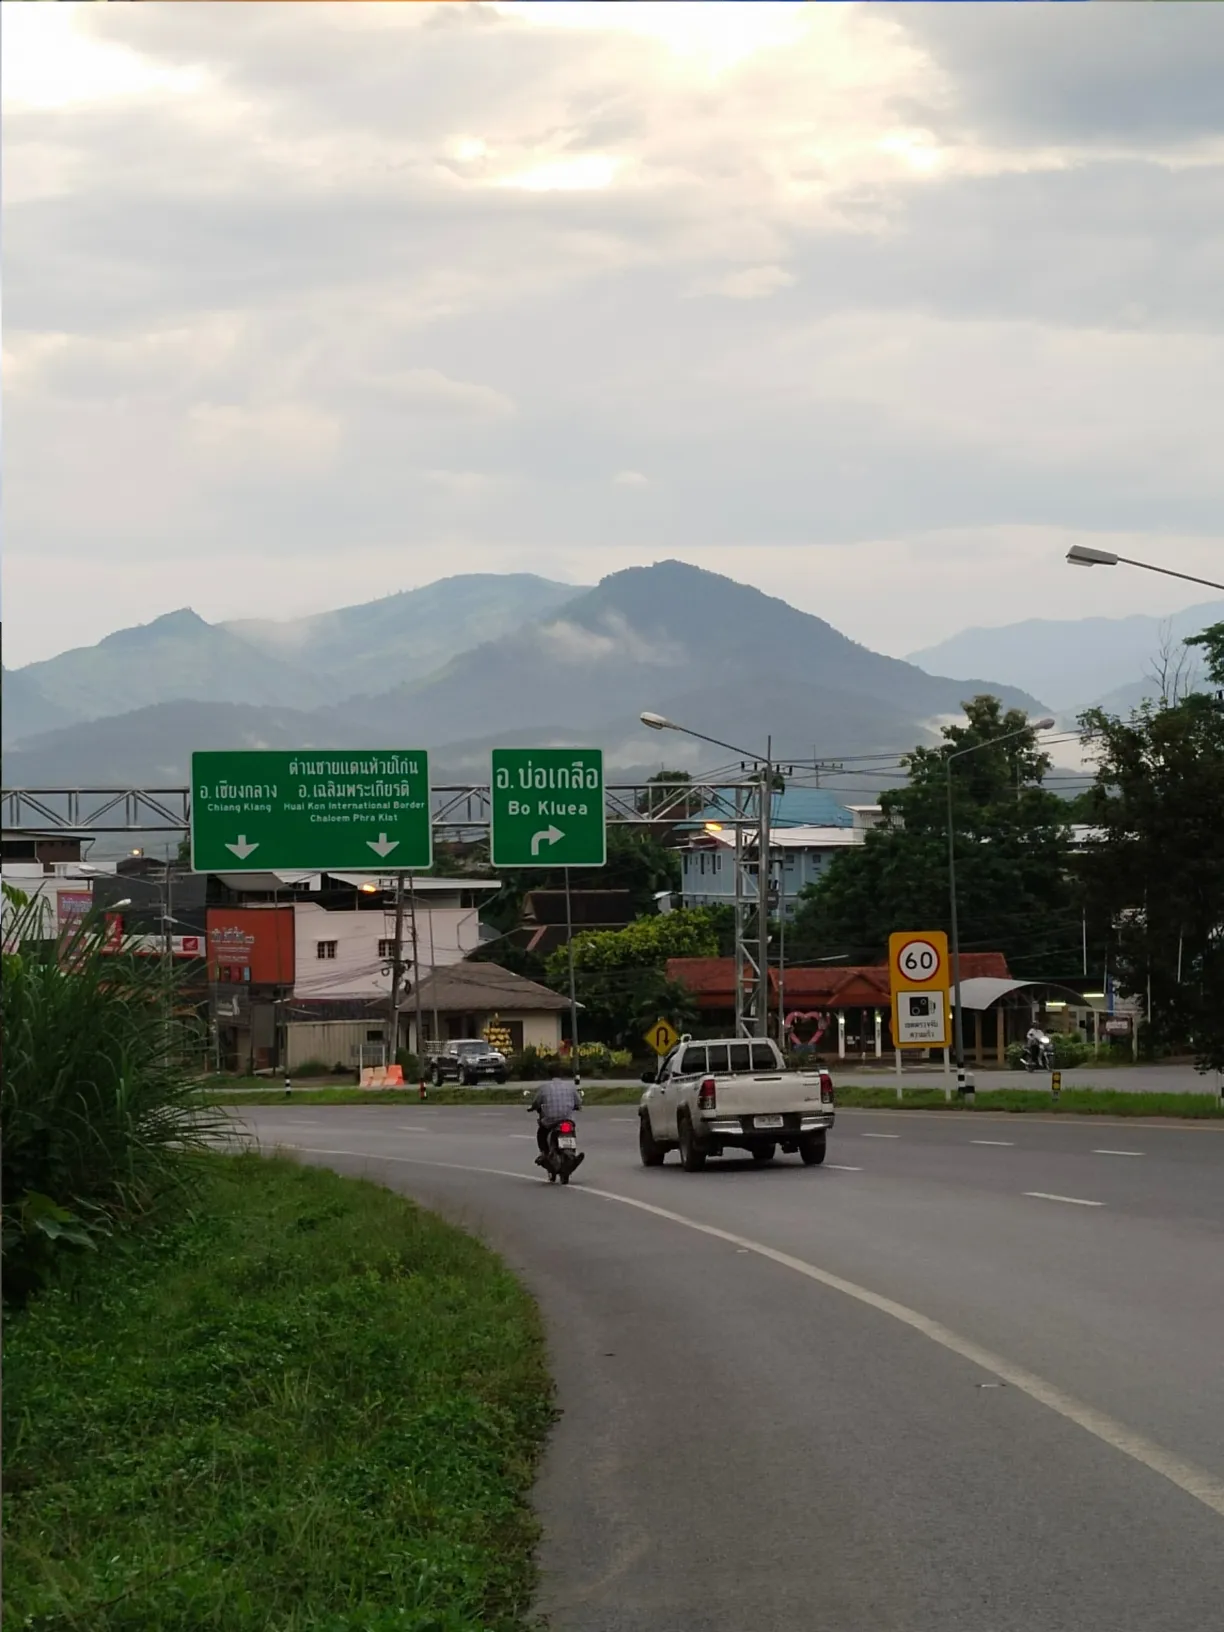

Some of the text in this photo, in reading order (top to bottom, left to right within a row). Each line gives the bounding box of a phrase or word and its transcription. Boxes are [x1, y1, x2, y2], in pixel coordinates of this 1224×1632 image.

[496, 759, 599, 789] อ. บ่อเกลือ
[215, 779, 278, 799] เชียงกลาง
[313, 779, 410, 798] เฉลิมพระเกียรติ
[207, 802, 272, 814] Chiang Klang
[307, 802, 326, 810] Kon
[328, 801, 391, 810] International
[393, 800, 425, 810] Border
[508, 800, 588, 816] Bo Kluea
[310, 813, 398, 823] Chaloem Phra Kiat
[905, 951, 933, 970] 60
